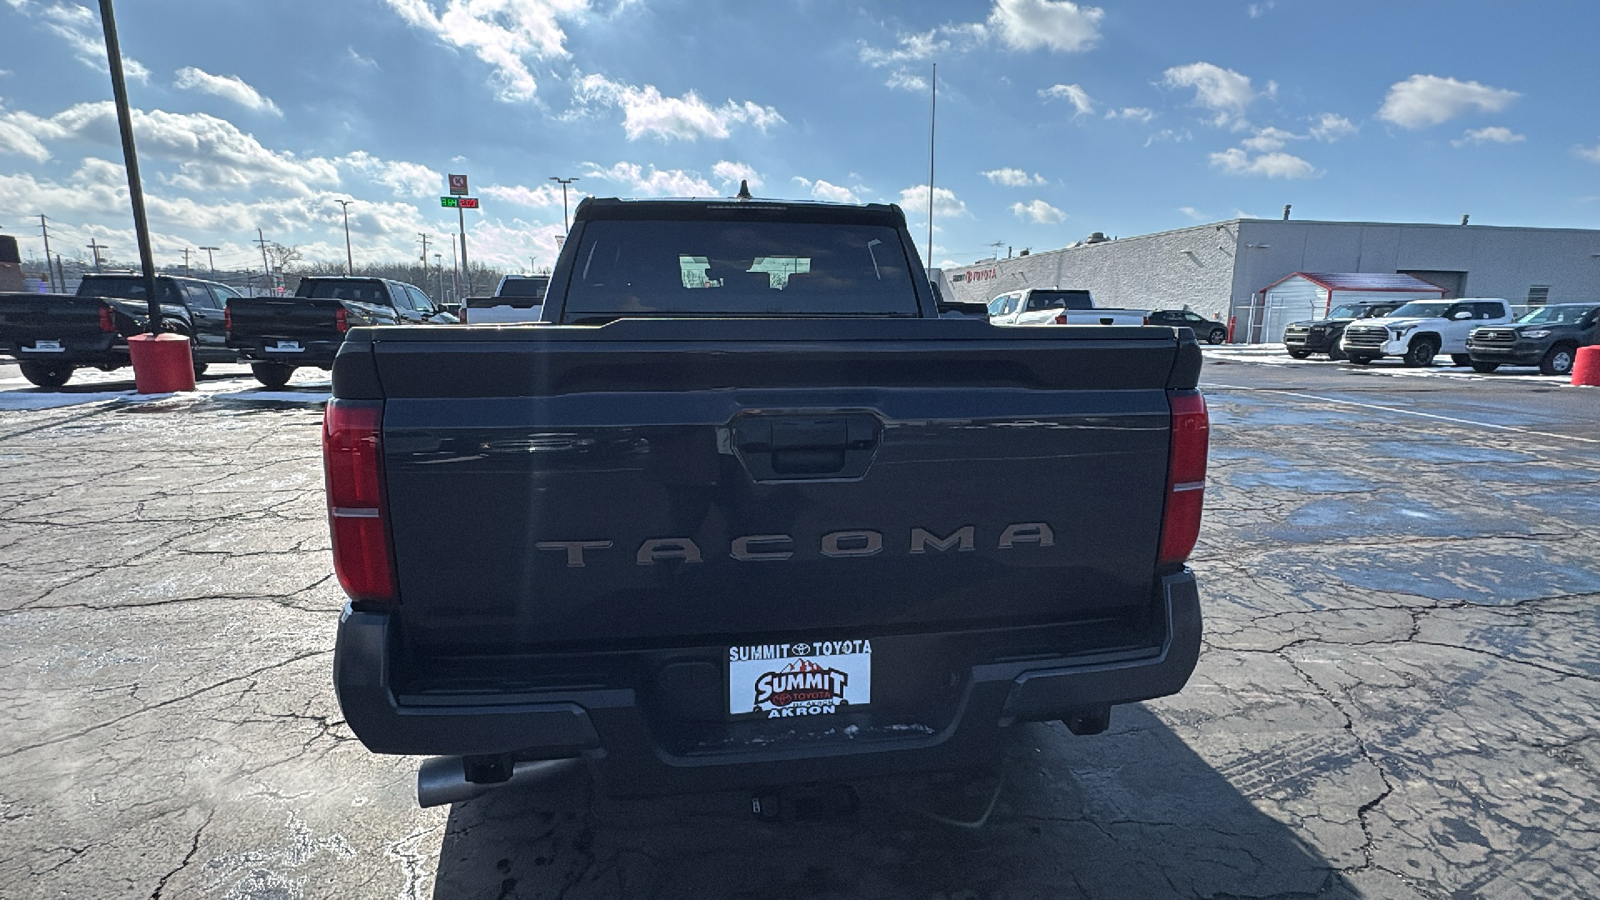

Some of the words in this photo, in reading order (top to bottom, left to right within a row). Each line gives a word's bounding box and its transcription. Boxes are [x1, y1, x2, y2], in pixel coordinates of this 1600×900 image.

[973, 268, 997, 281] TOYOTA
[535, 522, 1055, 568] TACOMA
[729, 643, 790, 661] SUMMIT
[813, 639, 872, 656] TOYOTA
[756, 669, 847, 704] SUMMIT
[793, 691, 831, 701] TOYOTA
[768, 705, 836, 718] AKRON
